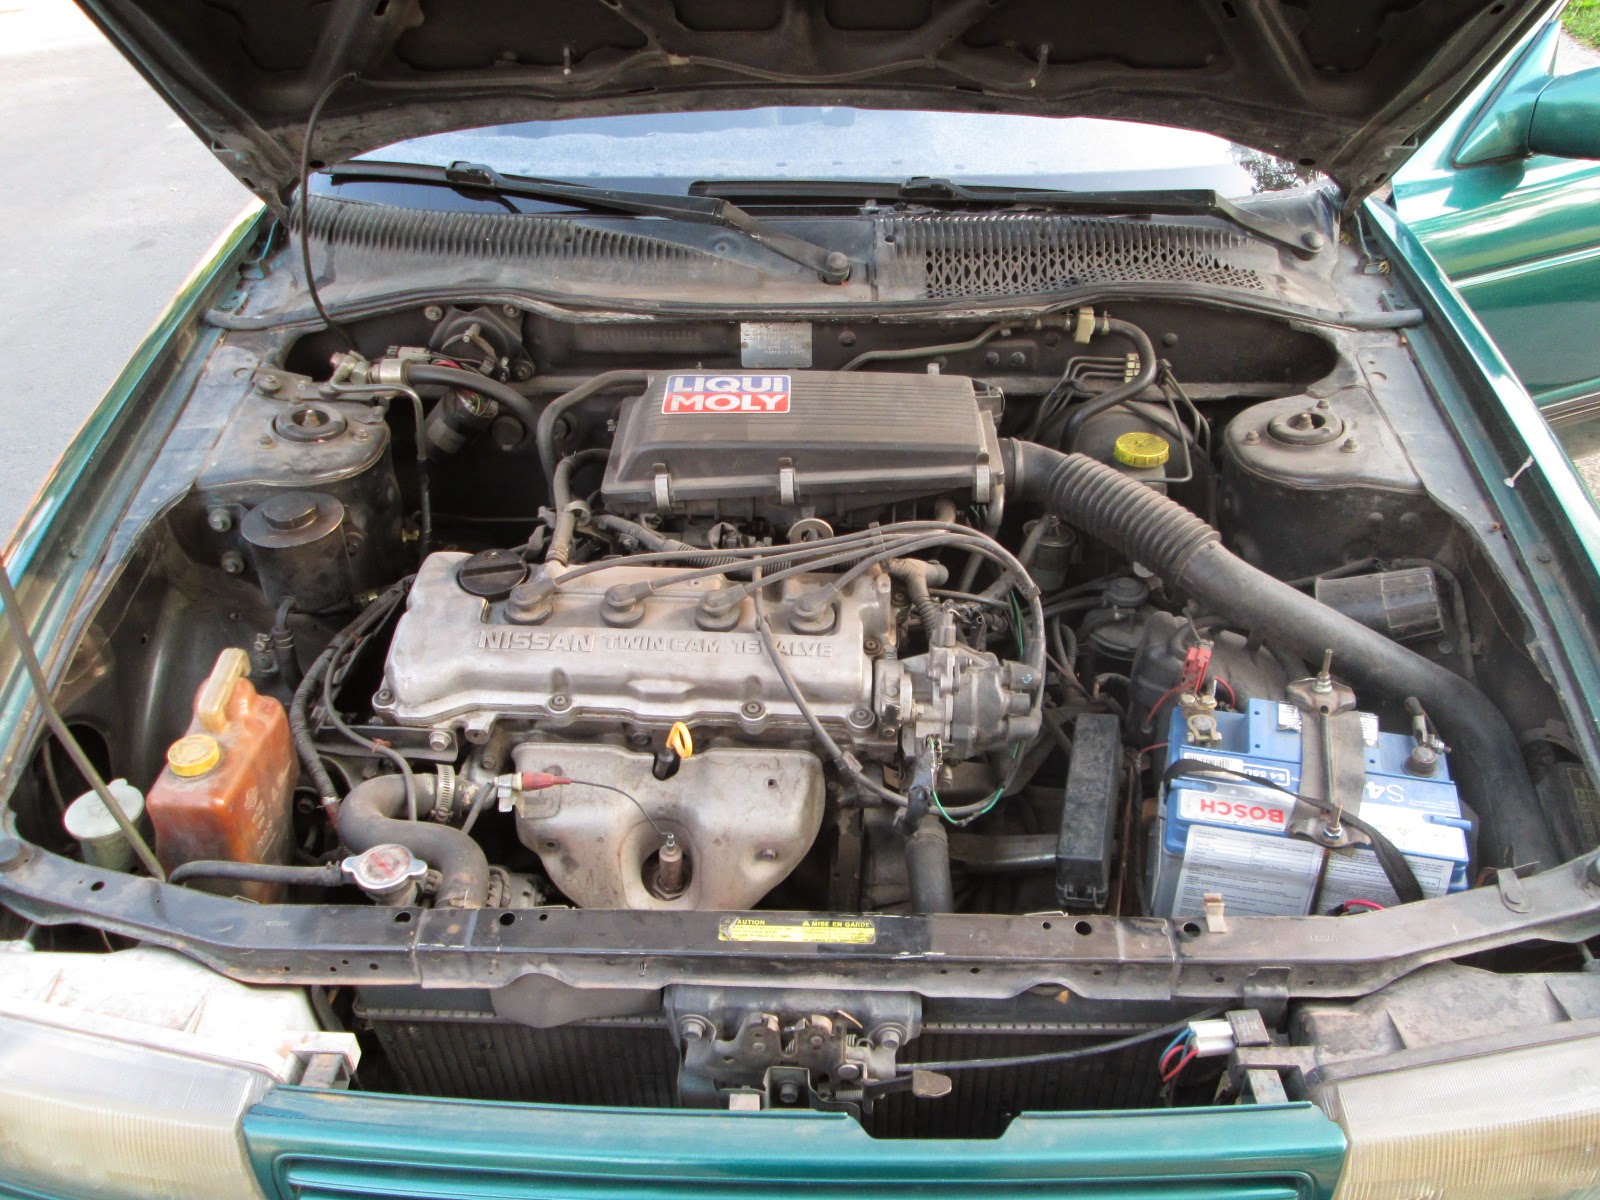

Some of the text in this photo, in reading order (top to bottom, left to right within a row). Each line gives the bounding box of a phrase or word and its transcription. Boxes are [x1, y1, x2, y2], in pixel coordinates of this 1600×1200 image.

[673, 377, 783, 393] LIQUI
[670, 394, 786, 411] MOLY
[478, 630, 595, 652] NISSAN
[604, 635, 667, 651] TWIN
[669, 639, 720, 653] CAM
[762, 640, 833, 657] ALVE
[1365, 781, 1405, 803] S4
[1200, 798, 1285, 823] BOSCH
